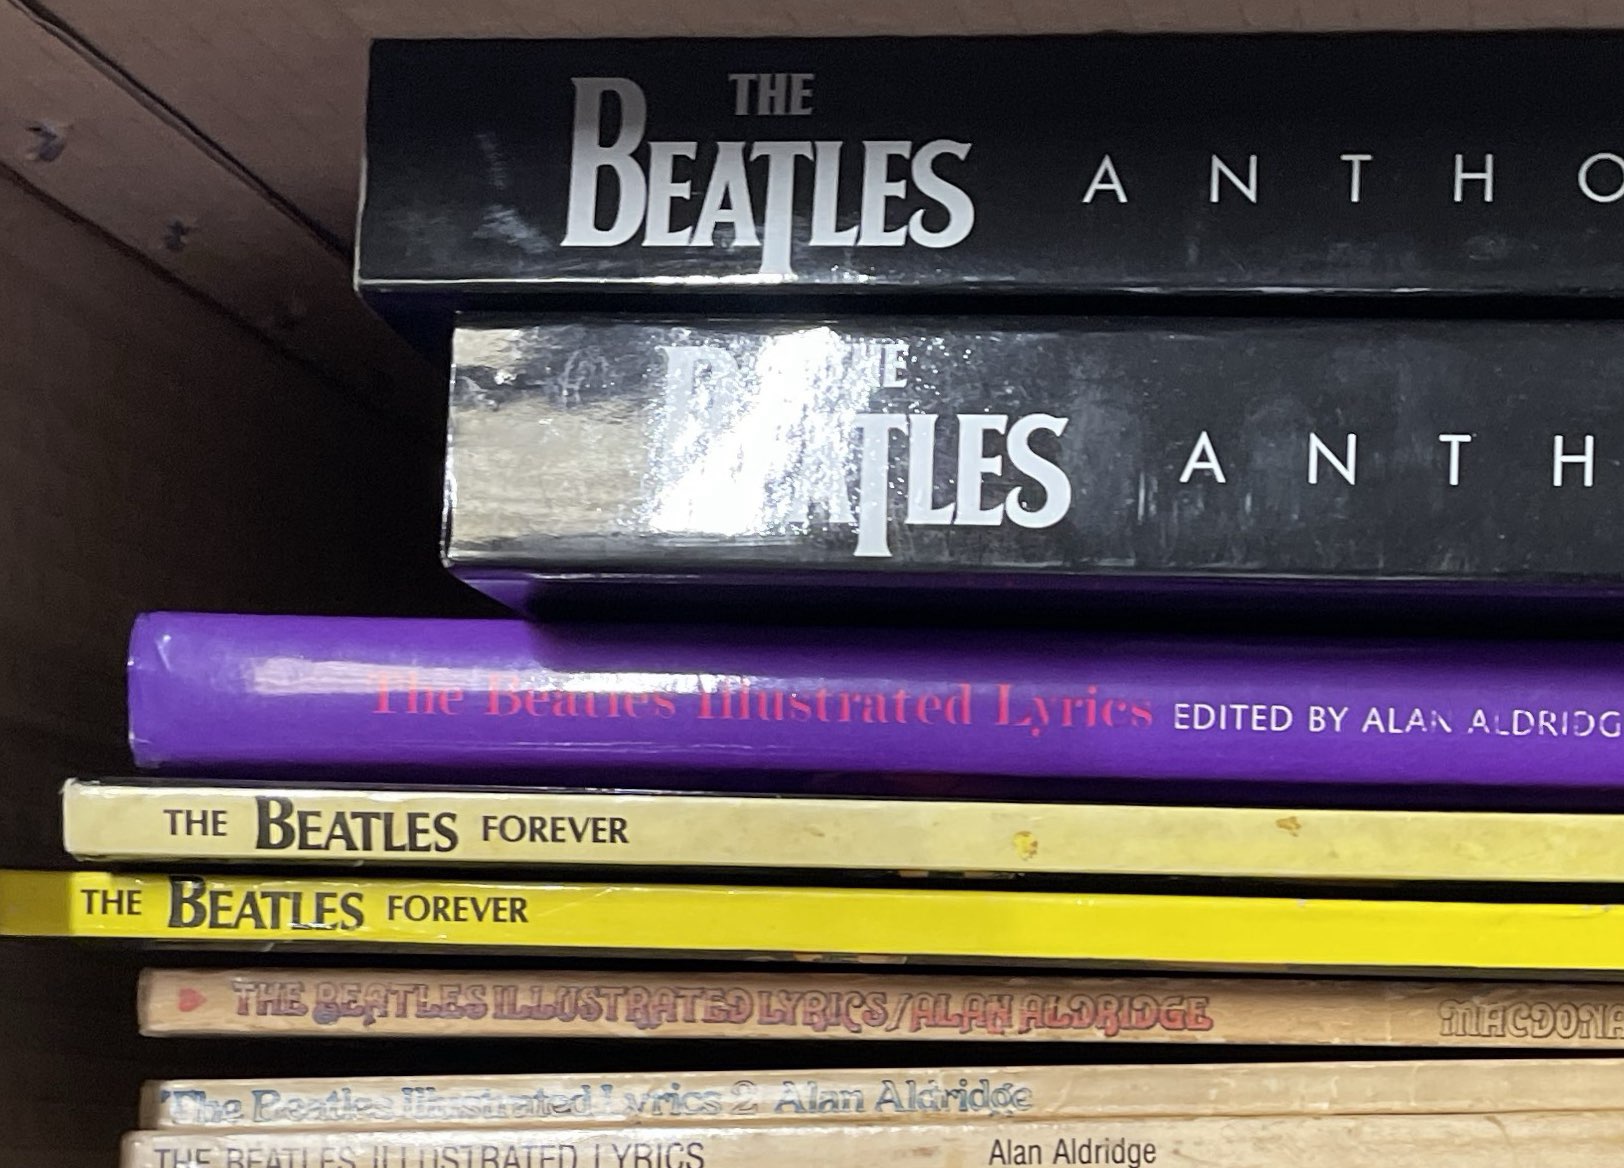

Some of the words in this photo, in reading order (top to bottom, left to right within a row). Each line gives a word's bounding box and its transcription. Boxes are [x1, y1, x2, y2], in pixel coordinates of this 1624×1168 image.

[729, 73, 814, 116] THE
[560, 76, 975, 274] BEATLES
[369, 673, 463, 716] The
[698, 678, 971, 726] Illustrated
[998, 683, 1153, 737] Lyrics
[1174, 703, 1293, 731] EDITED
[1308, 706, 1349, 733] BY
[1361, 707, 1452, 734] ALAN
[164, 808, 228, 837] THE
[255, 796, 458, 853] BEATLES
[481, 815, 630, 845] FOREVER
[80, 888, 143, 916] THE
[167, 875, 364, 932] BEATLES
[387, 895, 529, 924] FOREVER
[230, 981, 308, 1017] THE
[1017, 994, 1214, 1038] ALDRIDGE
[161, 1088, 245, 1125] The
[730, 1080, 760, 1116] 2
[774, 1081, 865, 1116] Alan
[875, 1078, 1034, 1119] Aldridge
[988, 1138, 1043, 1167] Alan
